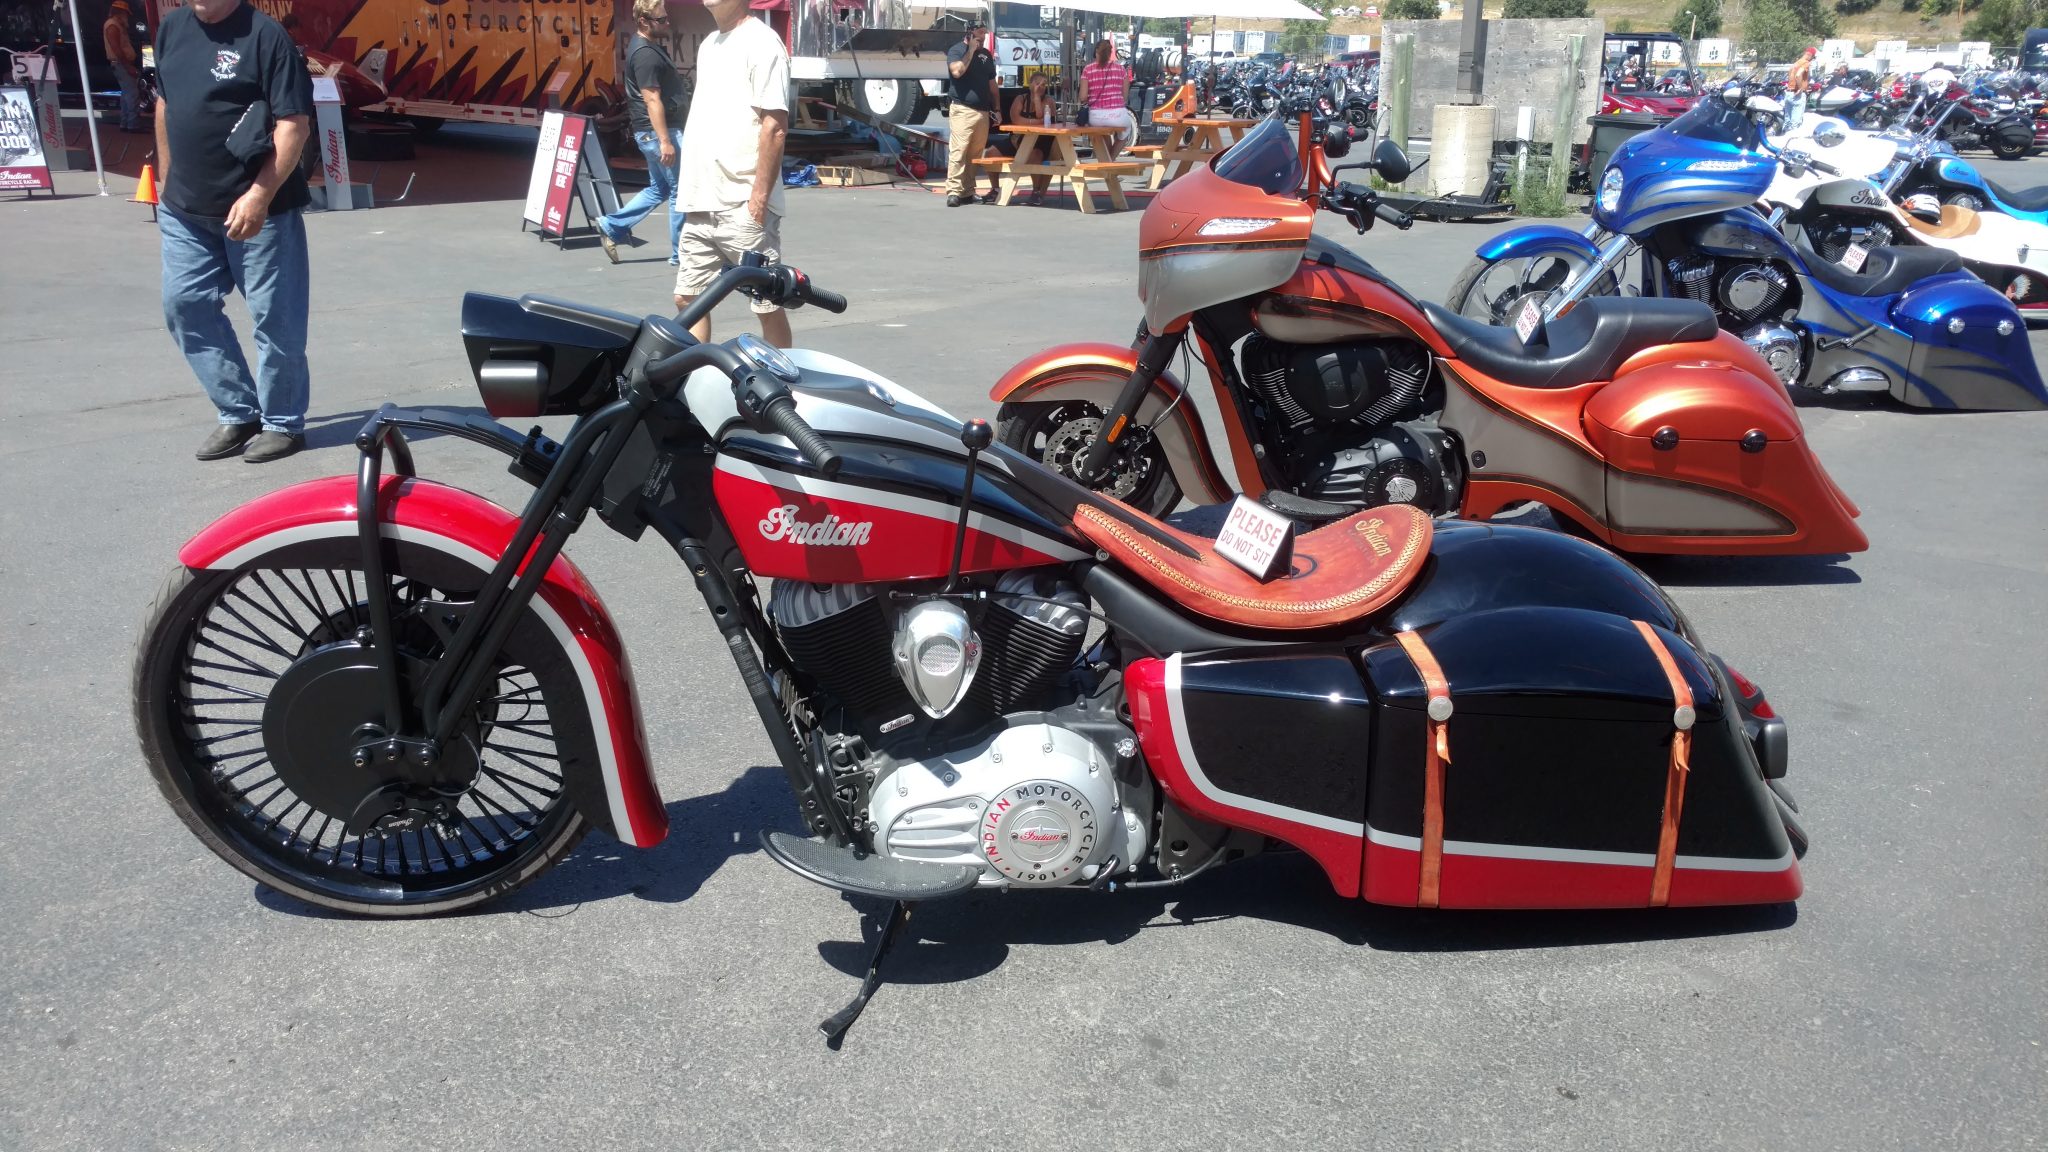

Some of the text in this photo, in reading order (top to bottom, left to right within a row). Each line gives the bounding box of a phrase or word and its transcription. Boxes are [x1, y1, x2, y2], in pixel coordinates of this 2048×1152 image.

[426, 13, 600, 36] MOTORCYCLE
[13, 55, 28, 74] 5
[43, 103, 59, 149] Indian
[326, 129, 342, 184] Indian
[0, 170, 32, 181] Indian
[1851, 189, 1888, 207] Indian
[758, 504, 873, 546] Indian
[1230, 506, 1283, 547] PLEASE
[1355, 518, 1392, 558] Indian
[1220, 529, 1270, 565] DO NOT SIT
[984, 785, 1094, 864] INDIAN MOTORCYCLE
[1020, 830, 1060, 841] Indian
[1016, 871, 1057, 881] 1901
